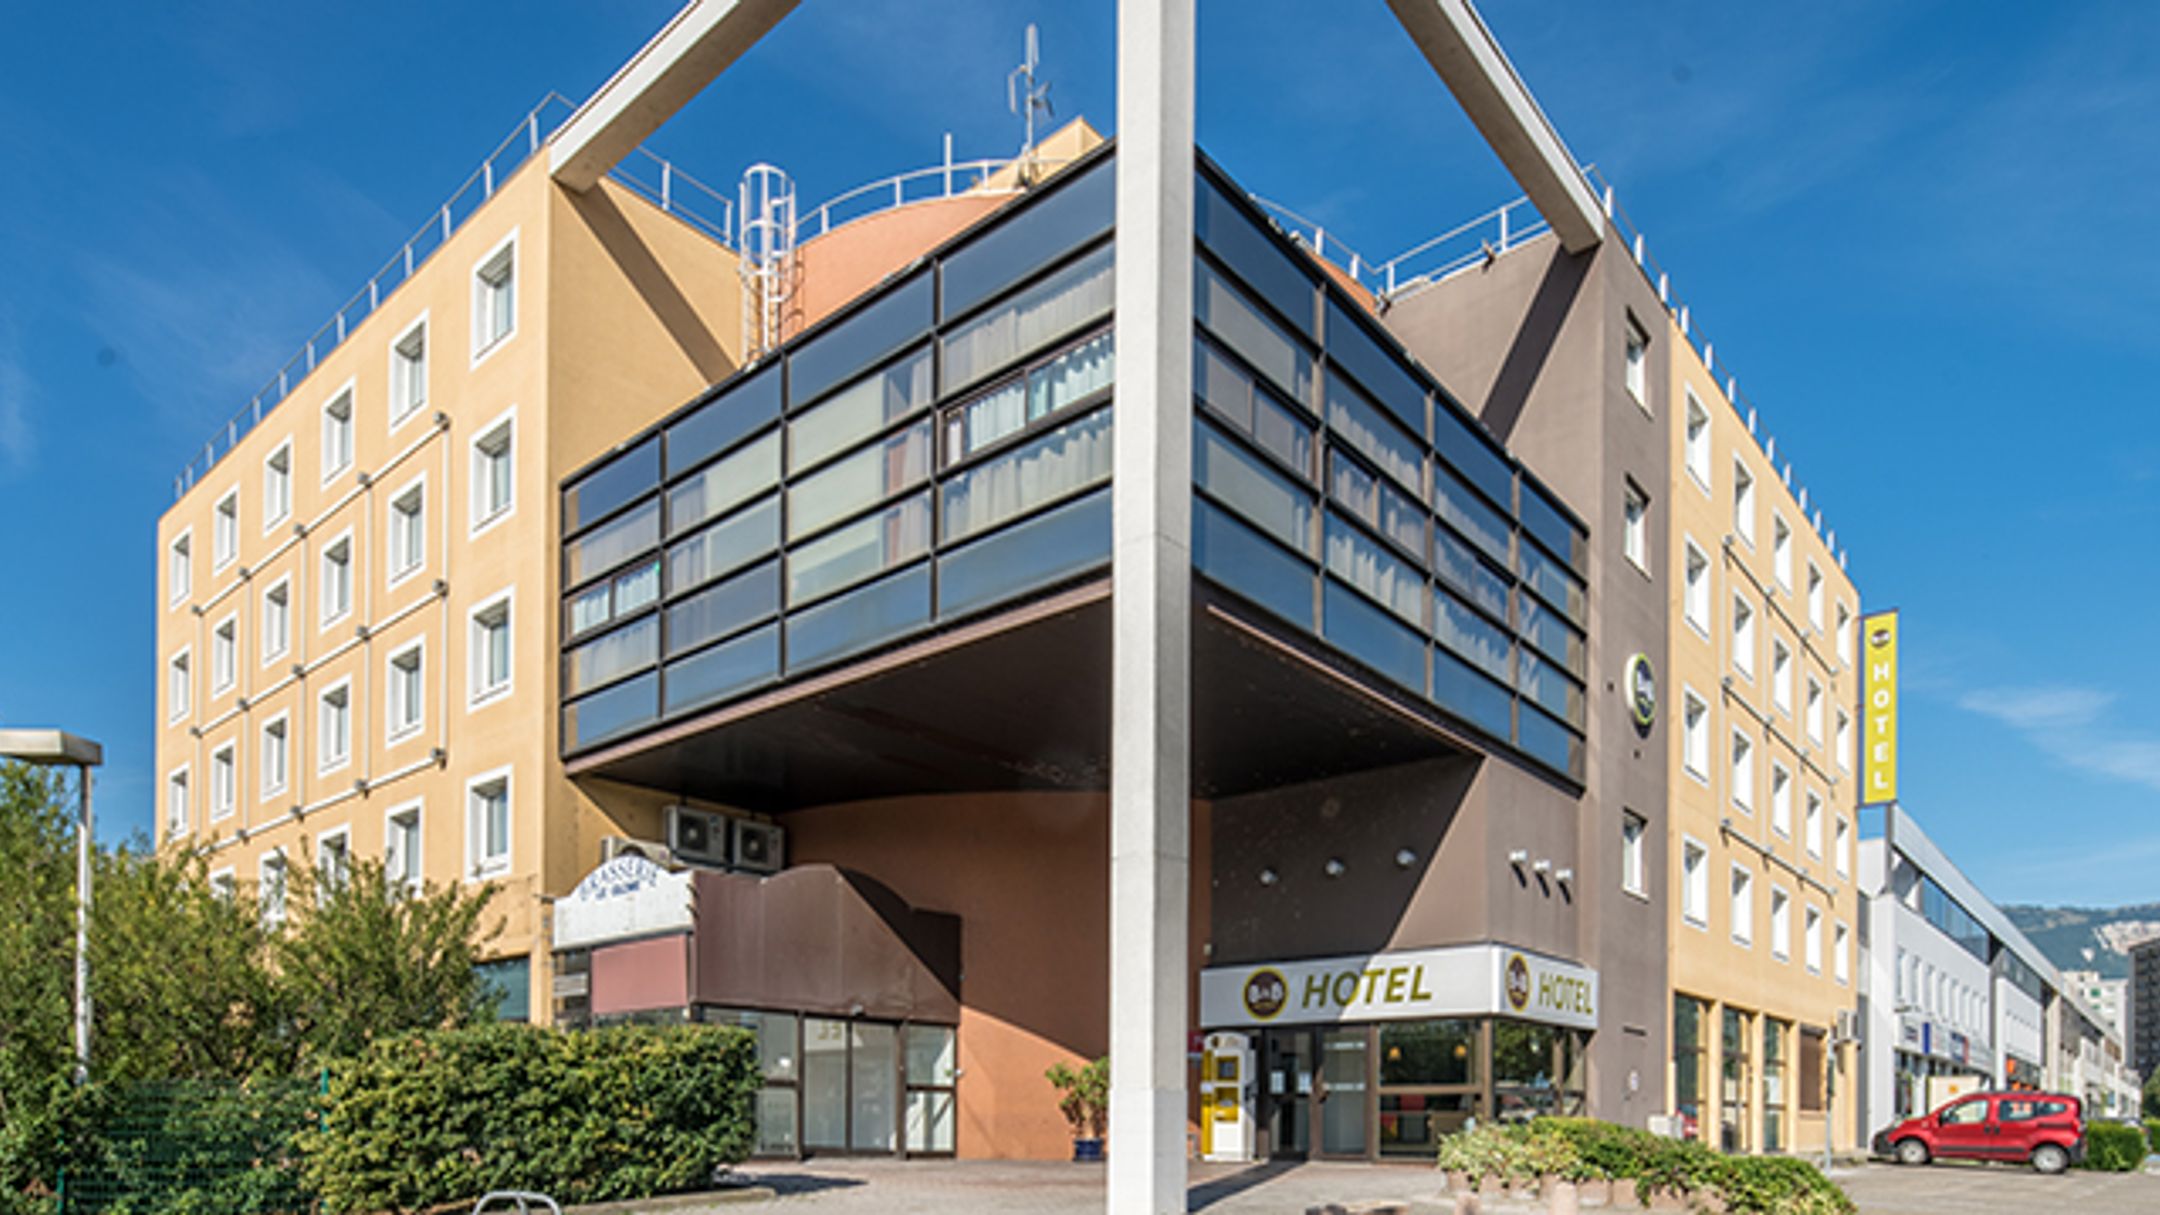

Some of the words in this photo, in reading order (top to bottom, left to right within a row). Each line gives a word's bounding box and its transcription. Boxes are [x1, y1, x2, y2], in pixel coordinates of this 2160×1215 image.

[1873, 662, 1890, 790] HOTEL
[1302, 965, 1432, 1009] HOTEL
[1538, 971, 1593, 1016] HOTEL
